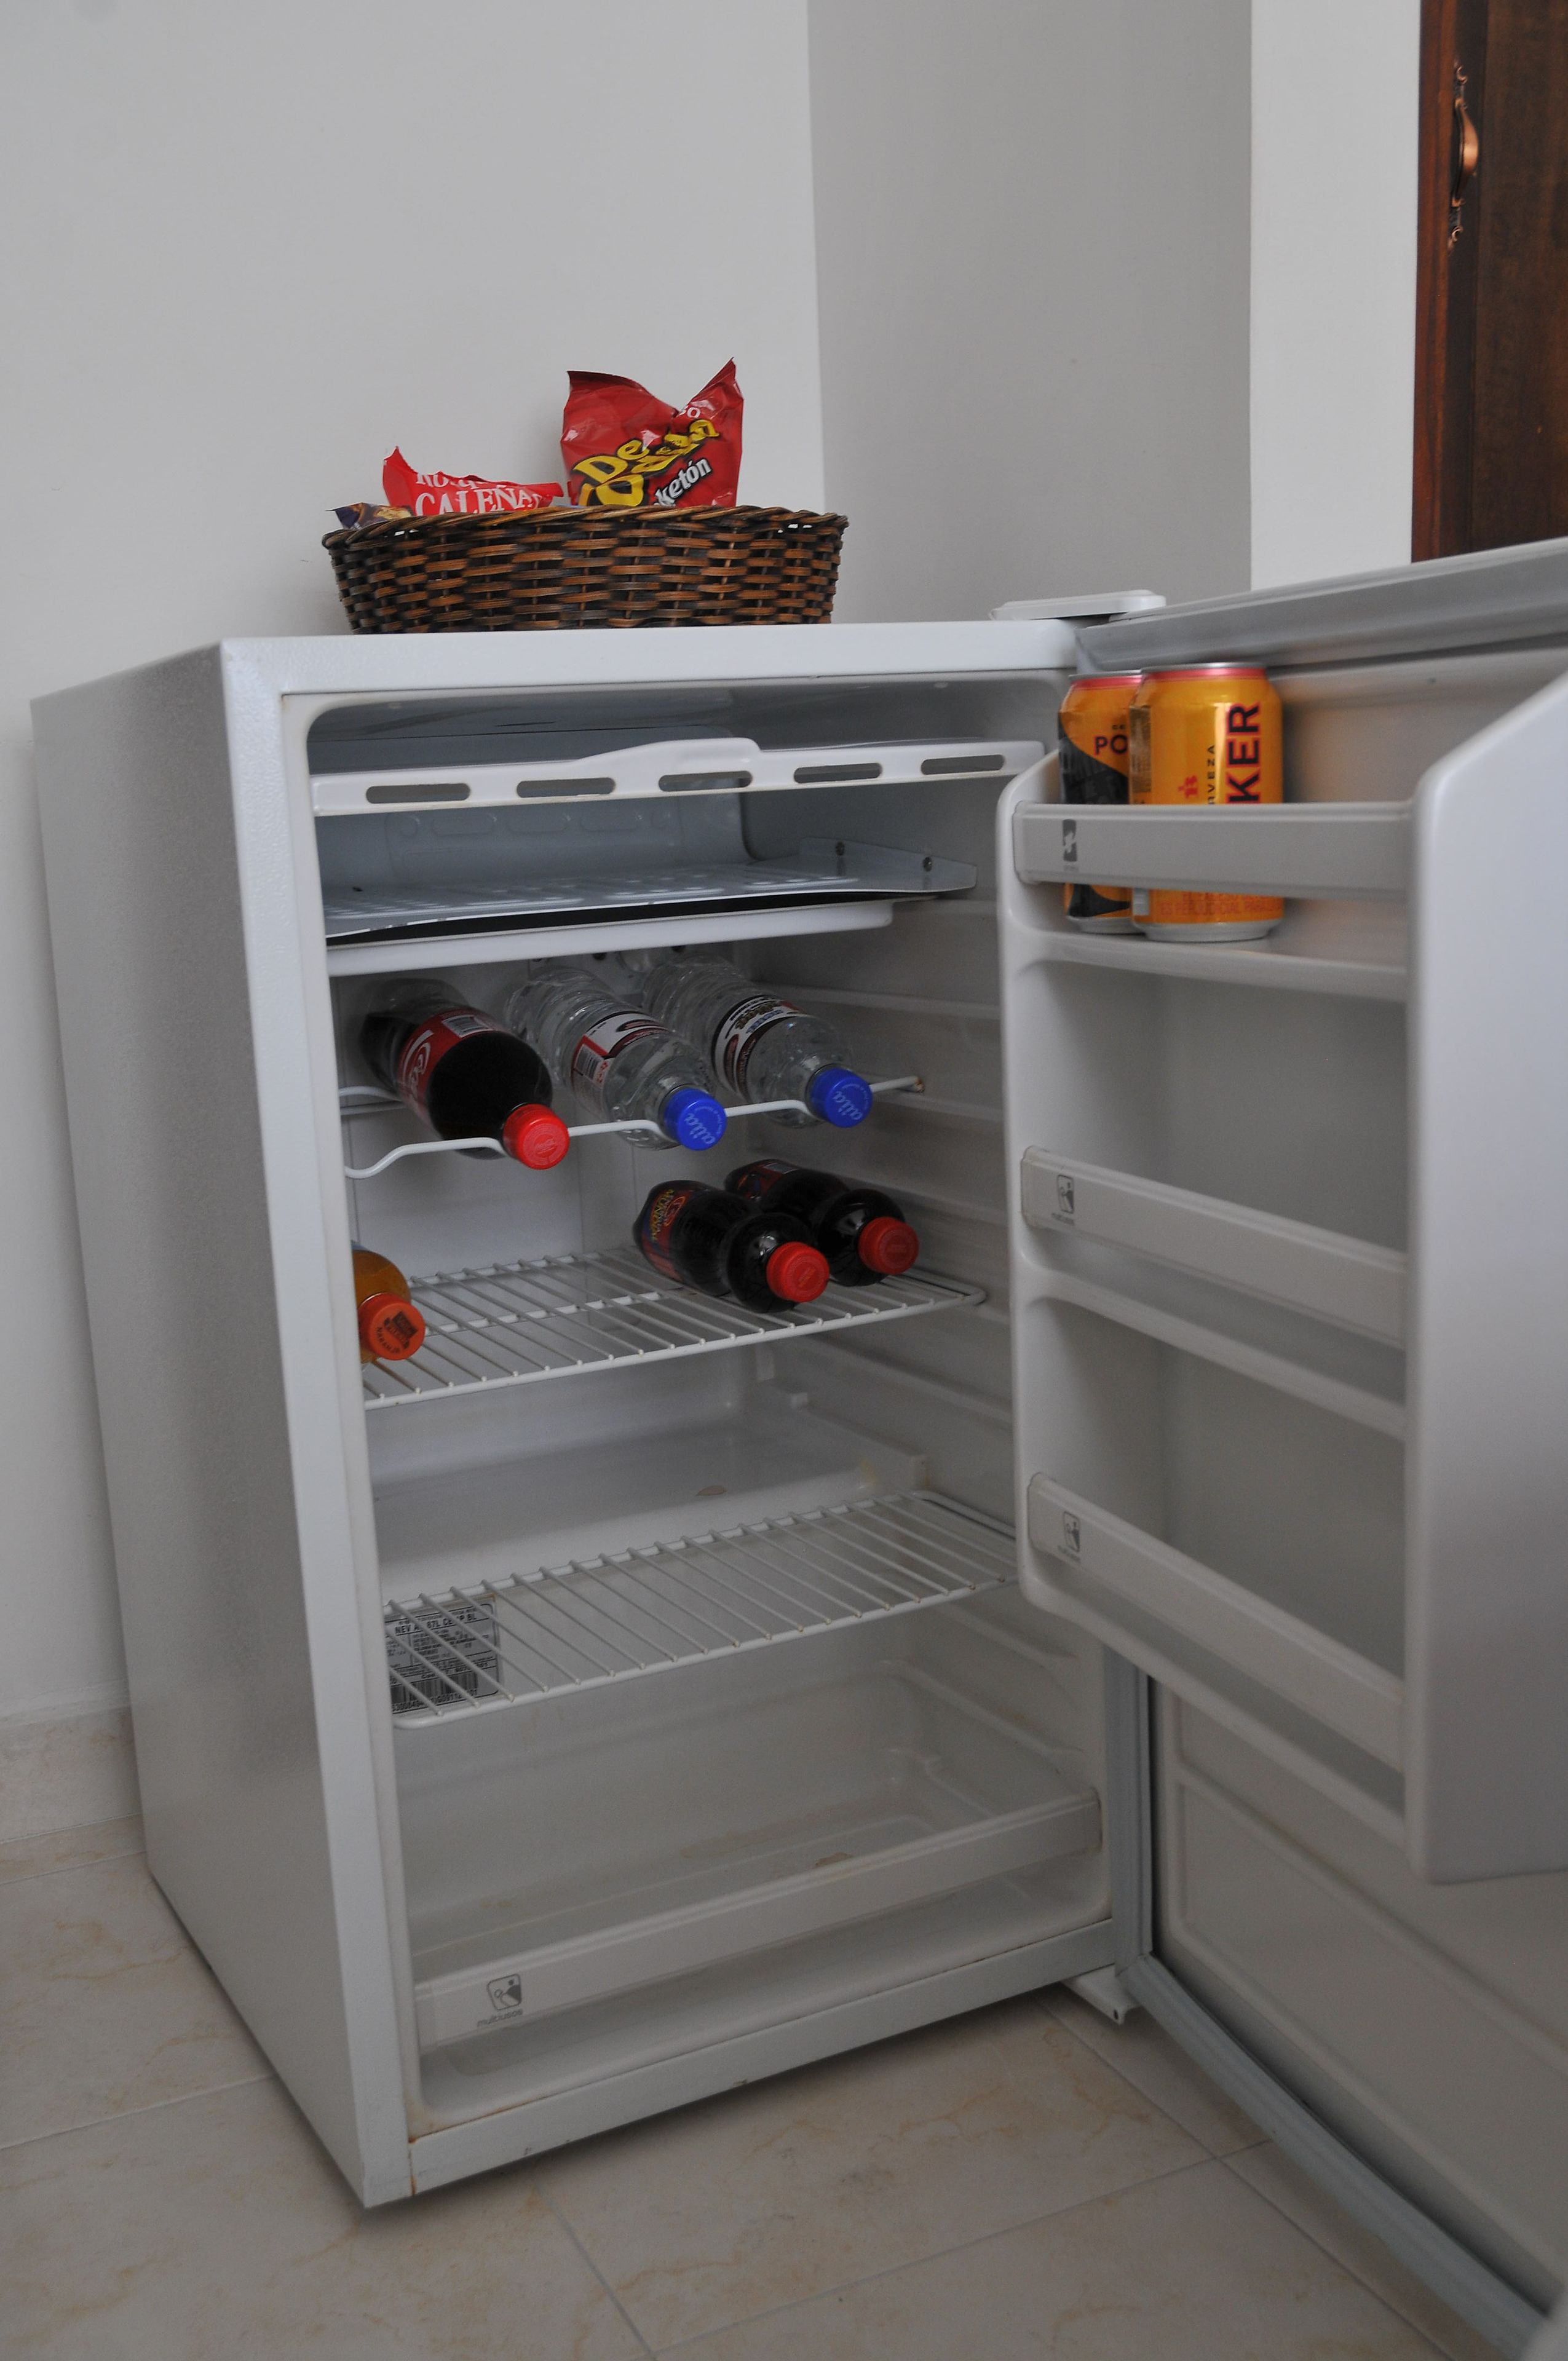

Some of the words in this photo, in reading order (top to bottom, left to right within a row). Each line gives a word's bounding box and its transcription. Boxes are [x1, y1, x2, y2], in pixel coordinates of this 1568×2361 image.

[573, 439, 650, 484] De
[654, 458, 712, 507] ketón
[1207, 745, 1216, 804] RVEZA
[1226, 703, 1260, 804] KER
